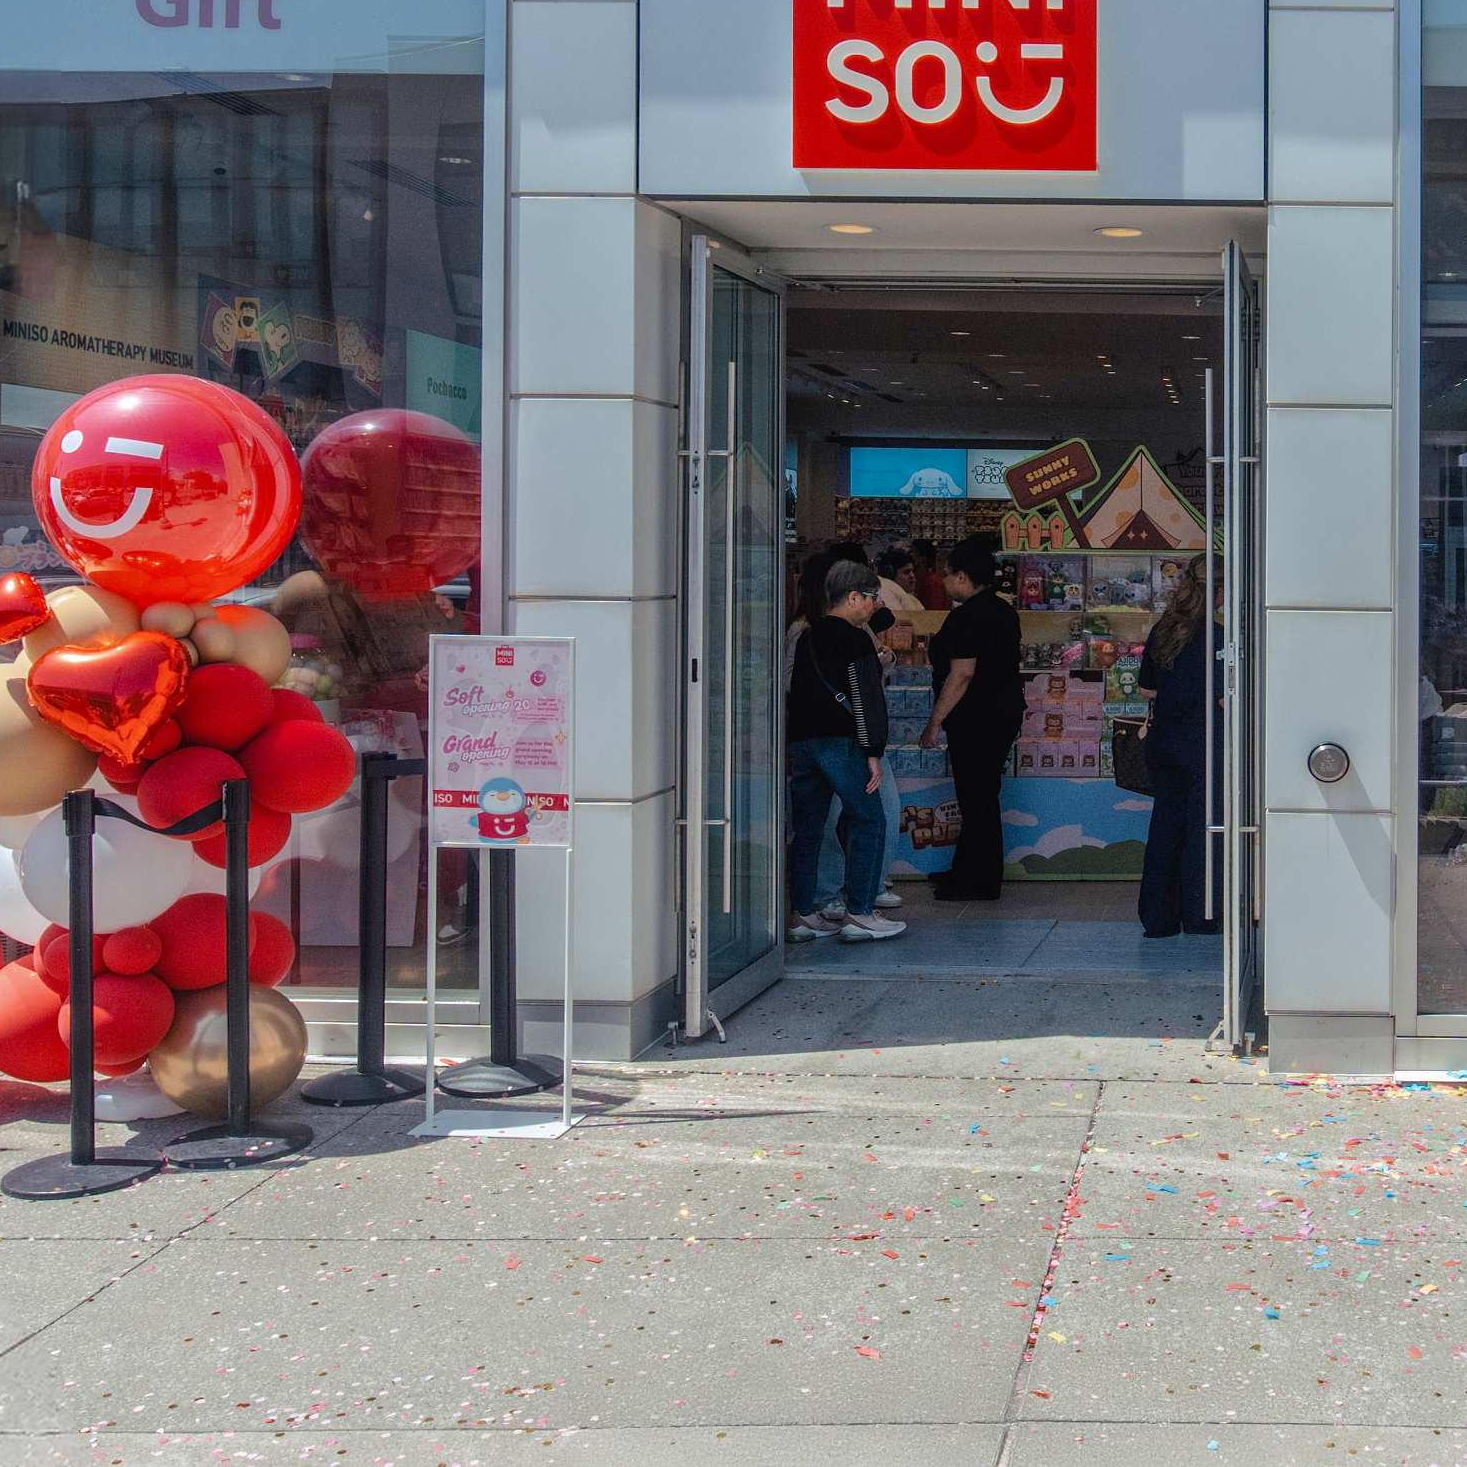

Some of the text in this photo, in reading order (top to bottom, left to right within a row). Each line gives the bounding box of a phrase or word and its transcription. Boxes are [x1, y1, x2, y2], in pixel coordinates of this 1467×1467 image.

[2, 319, 194, 371] MINISO AROMATHERAPY MUSEUM
[1025, 455, 1070, 483] SUNNY
[1028, 467, 1078, 496] WORKS
[443, 685, 485, 707] Soft
[462, 700, 511, 717] opening
[443, 731, 498, 754] Grand
[461, 746, 510, 765] opening
